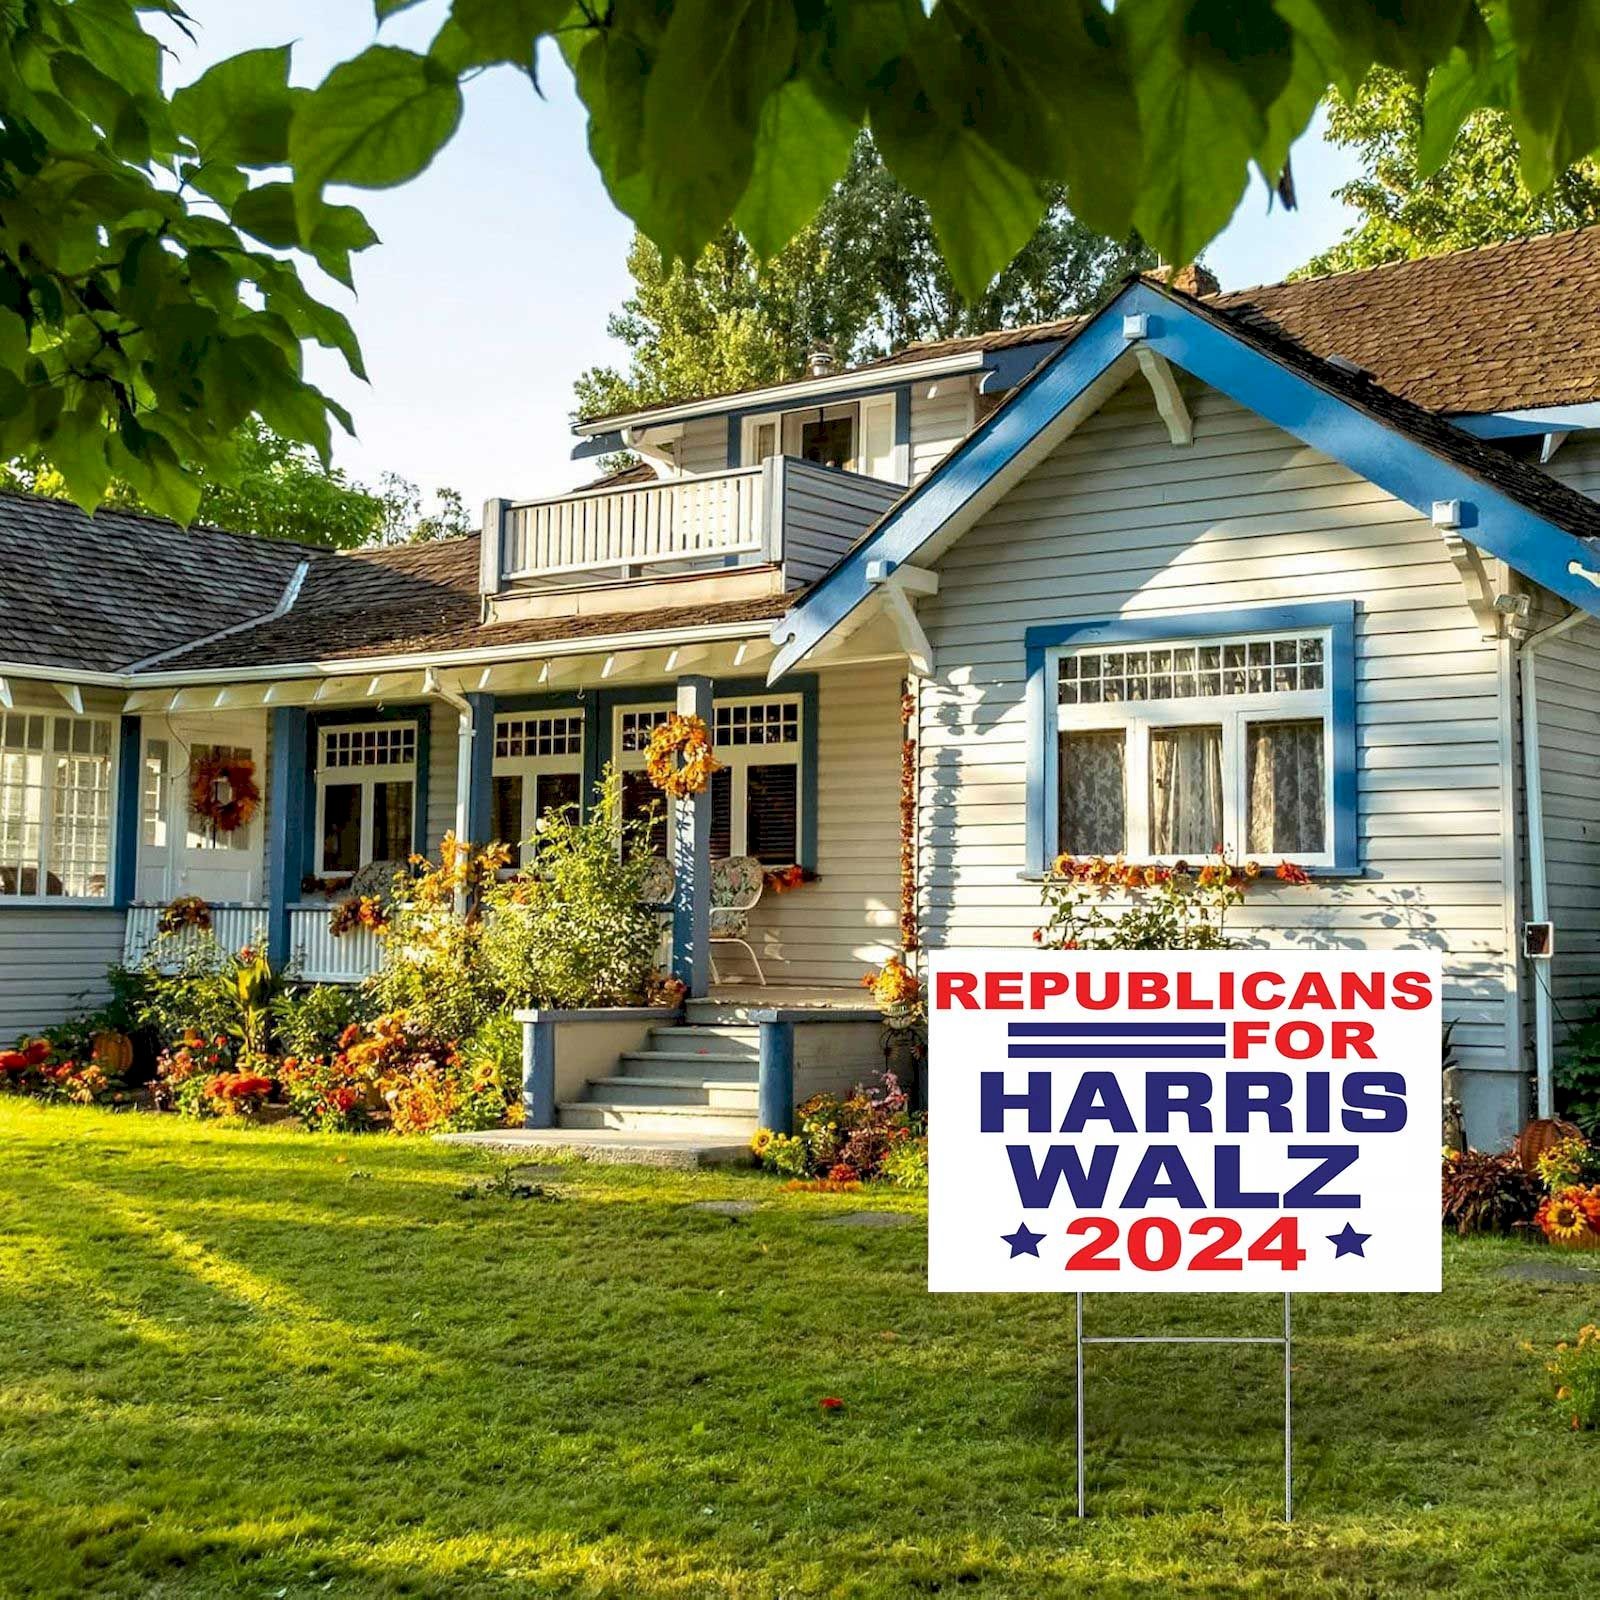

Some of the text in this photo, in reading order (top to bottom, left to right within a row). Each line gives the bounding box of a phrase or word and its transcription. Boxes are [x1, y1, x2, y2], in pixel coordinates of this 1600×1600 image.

[936, 971, 1433, 1011] REPUBLICANS
[1233, 1021, 1377, 1060] FOR
[980, 1071, 1408, 1133] HARRIS
[1006, 1144, 1361, 1209] WALZ
[1065, 1216, 1307, 1272] 2024
